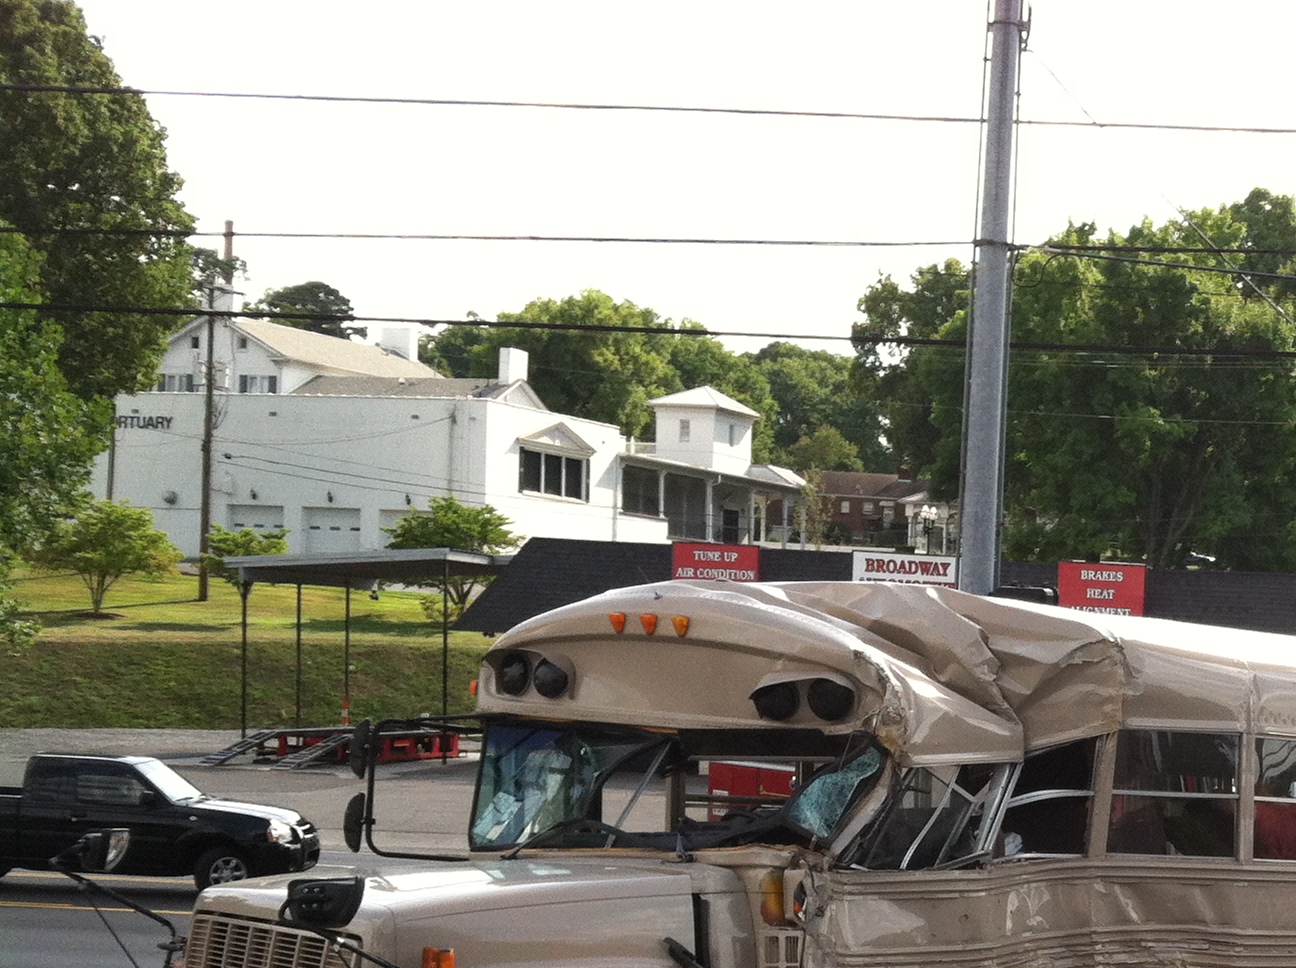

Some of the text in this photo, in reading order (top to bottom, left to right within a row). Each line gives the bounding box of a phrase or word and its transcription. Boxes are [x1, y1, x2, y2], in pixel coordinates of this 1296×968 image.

[693, 550, 738, 562] TUNE UP
[676, 567, 755, 580] AIR CONDITION
[865, 558, 951, 576] BROADWAY
[1080, 569, 1123, 582] BRAKES
[1086, 588, 1115, 599] HEAT
